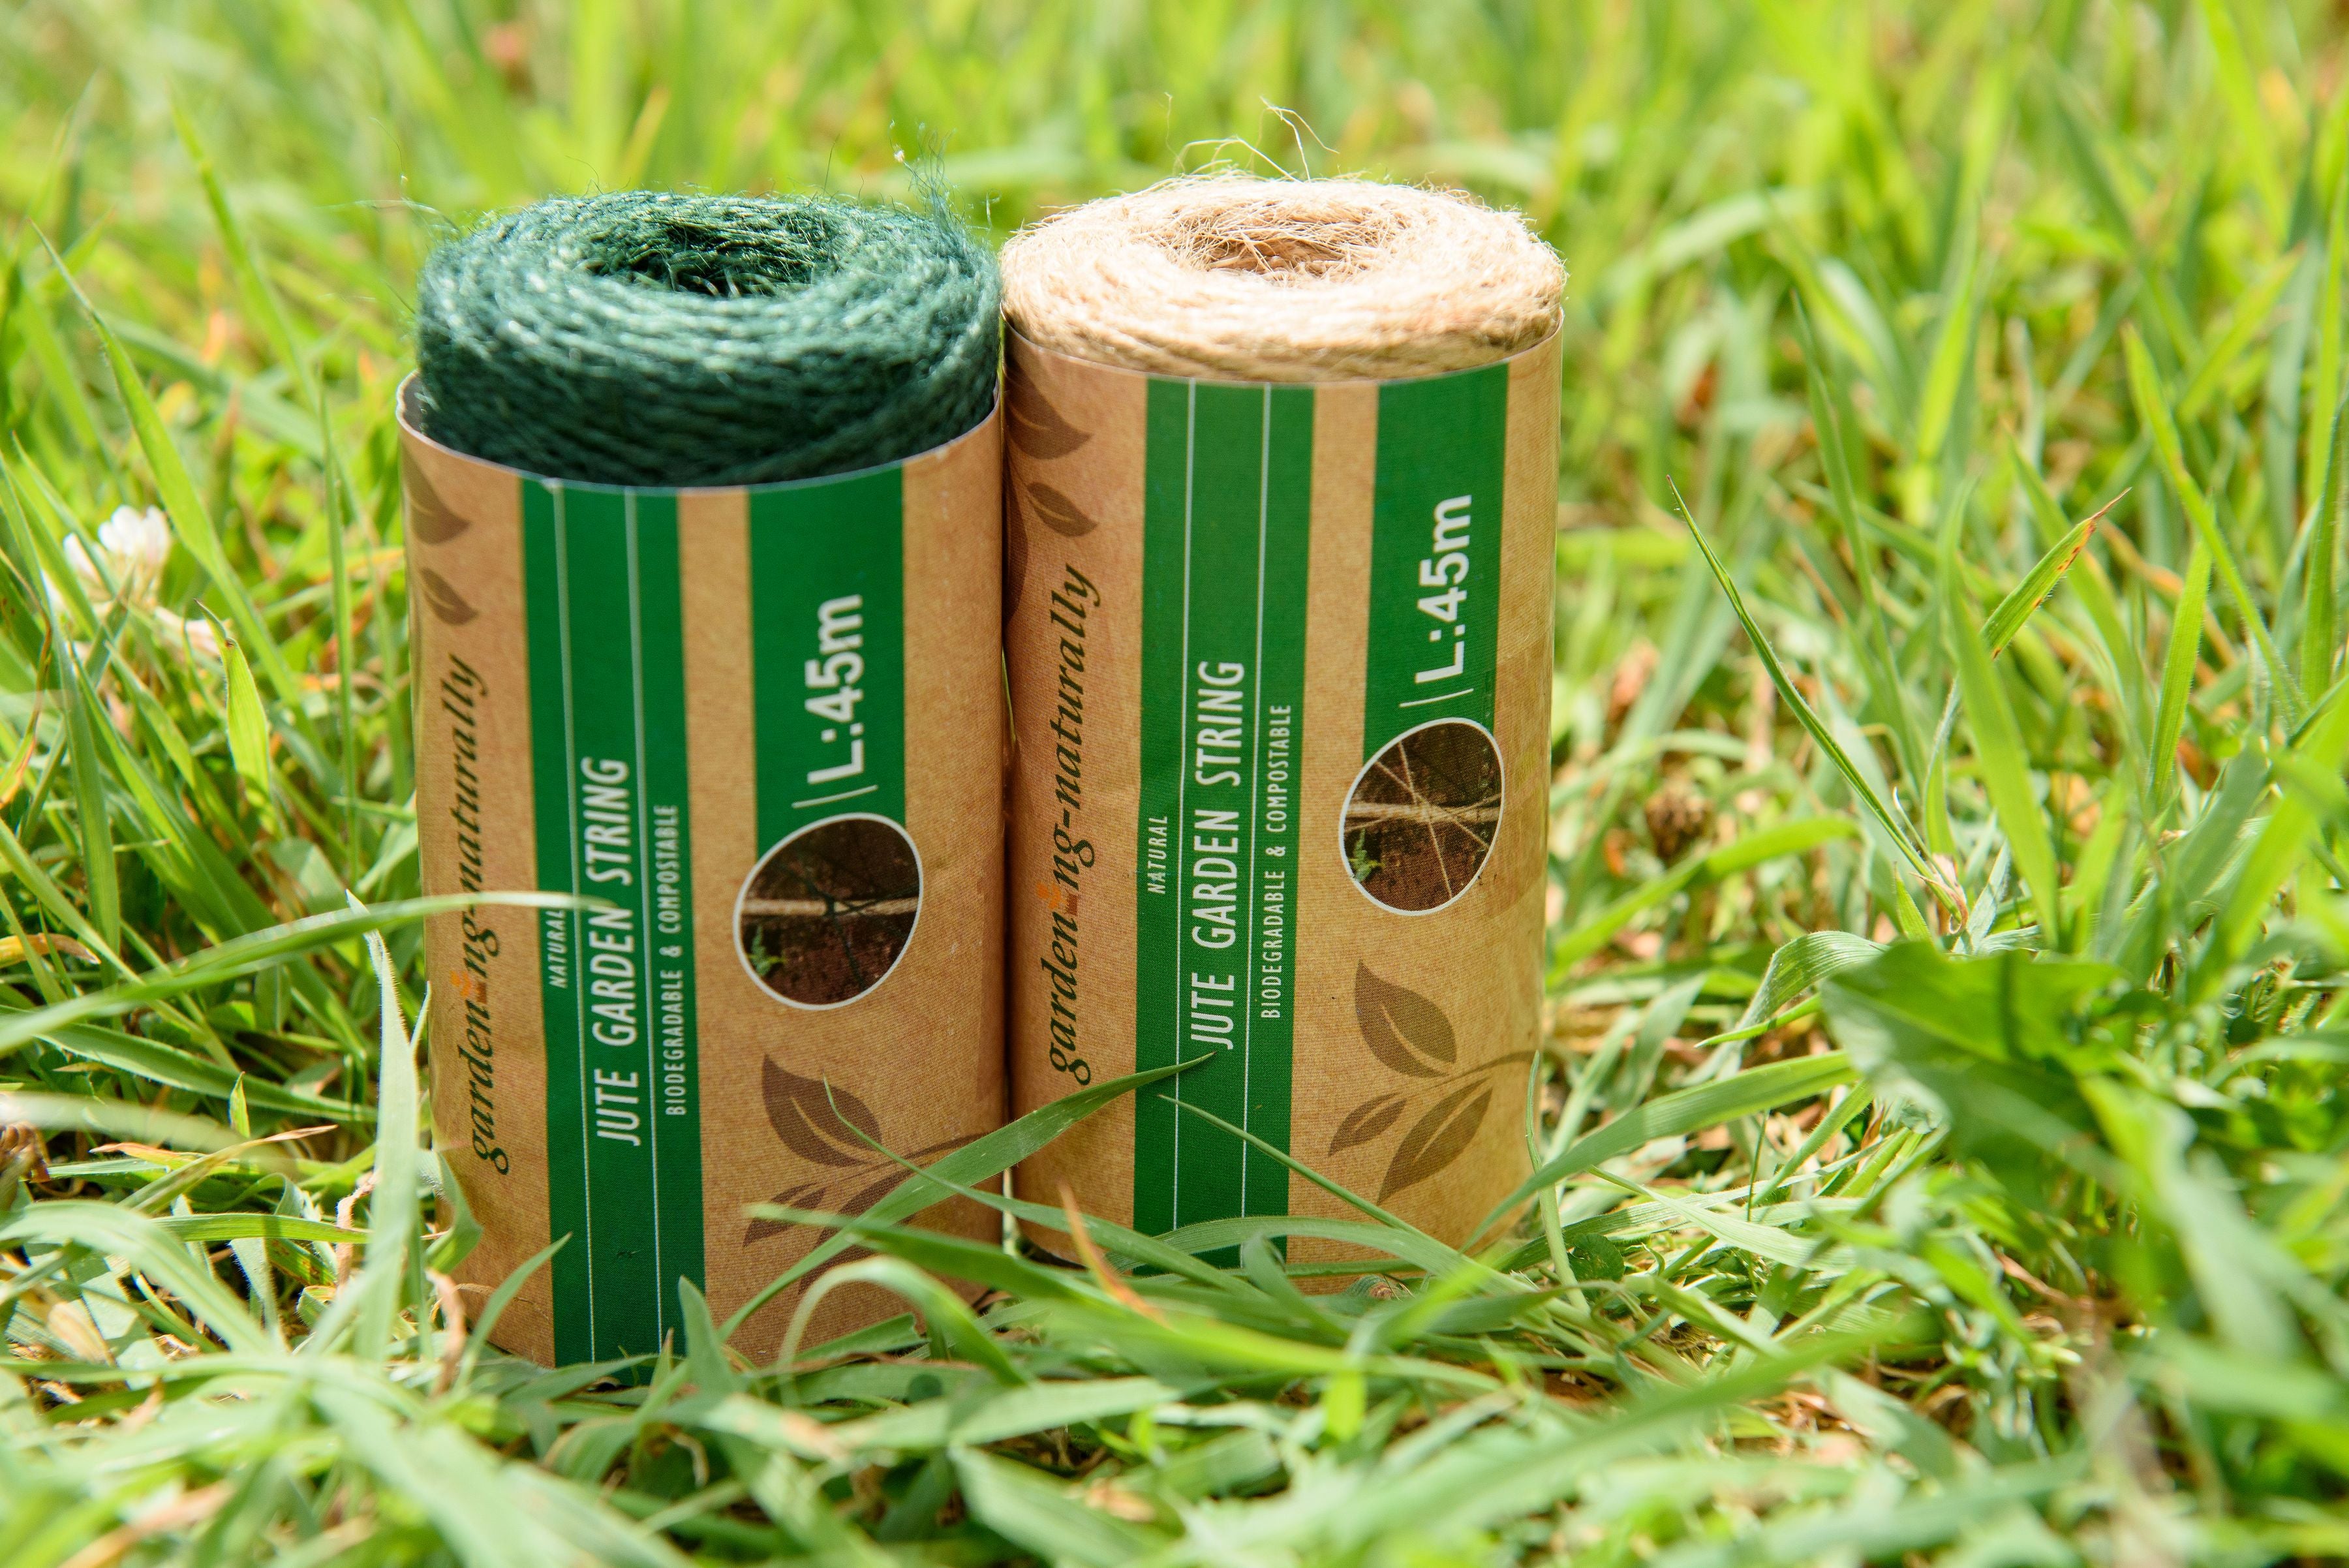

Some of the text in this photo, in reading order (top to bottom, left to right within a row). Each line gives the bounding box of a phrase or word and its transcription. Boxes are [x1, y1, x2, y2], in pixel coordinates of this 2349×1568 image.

[804, 594, 865, 785] L:45m
[1415, 494, 1472, 684] L:45m
[545, 909, 568, 989] NATURAL
[581, 757, 641, 1146] JUTE GARDEN STRING
[654, 805, 687, 1116] BIODEGRADABLE & COMPOSTABLE
[1146, 816, 1169, 895] NATURAL
[1190, 660, 1245, 1051] JUTE GARDEN STRING
[1260, 704, 1292, 1019] BIODEGRADABLE & COMPOSTABLE
